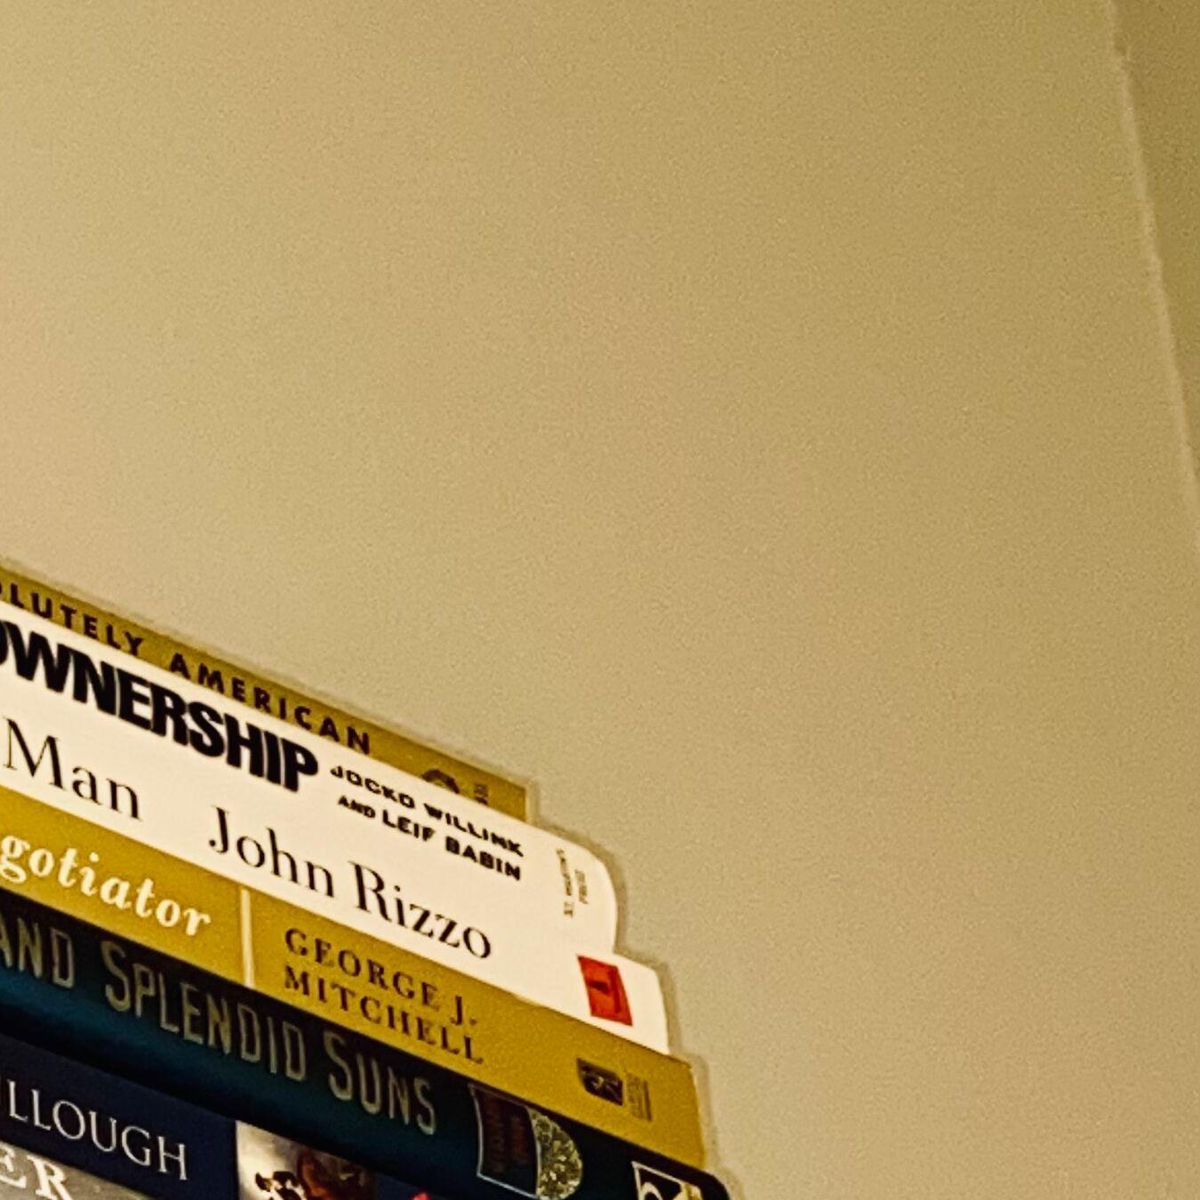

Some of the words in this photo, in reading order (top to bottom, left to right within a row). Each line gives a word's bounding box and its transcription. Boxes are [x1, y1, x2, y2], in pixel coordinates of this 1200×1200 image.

[169, 652, 371, 757] AMERICAN
[3, 716, 144, 822] Man
[330, 765, 415, 810] JOCKO
[423, 802, 525, 858] WILLINK
[208, 806, 335, 899] John
[347, 860, 492, 961] Rizzo
[337, 796, 376, 820] AND
[382, 809, 437, 843] LEIF
[445, 835, 522, 882] BABIN
[284, 927, 441, 1012] GEORGE
[448, 994, 479, 1028] J.
[284, 965, 485, 1065] MITCHELL
[101, 939, 307, 1083] SPLENDID
[322, 1030, 438, 1136] SUNS
